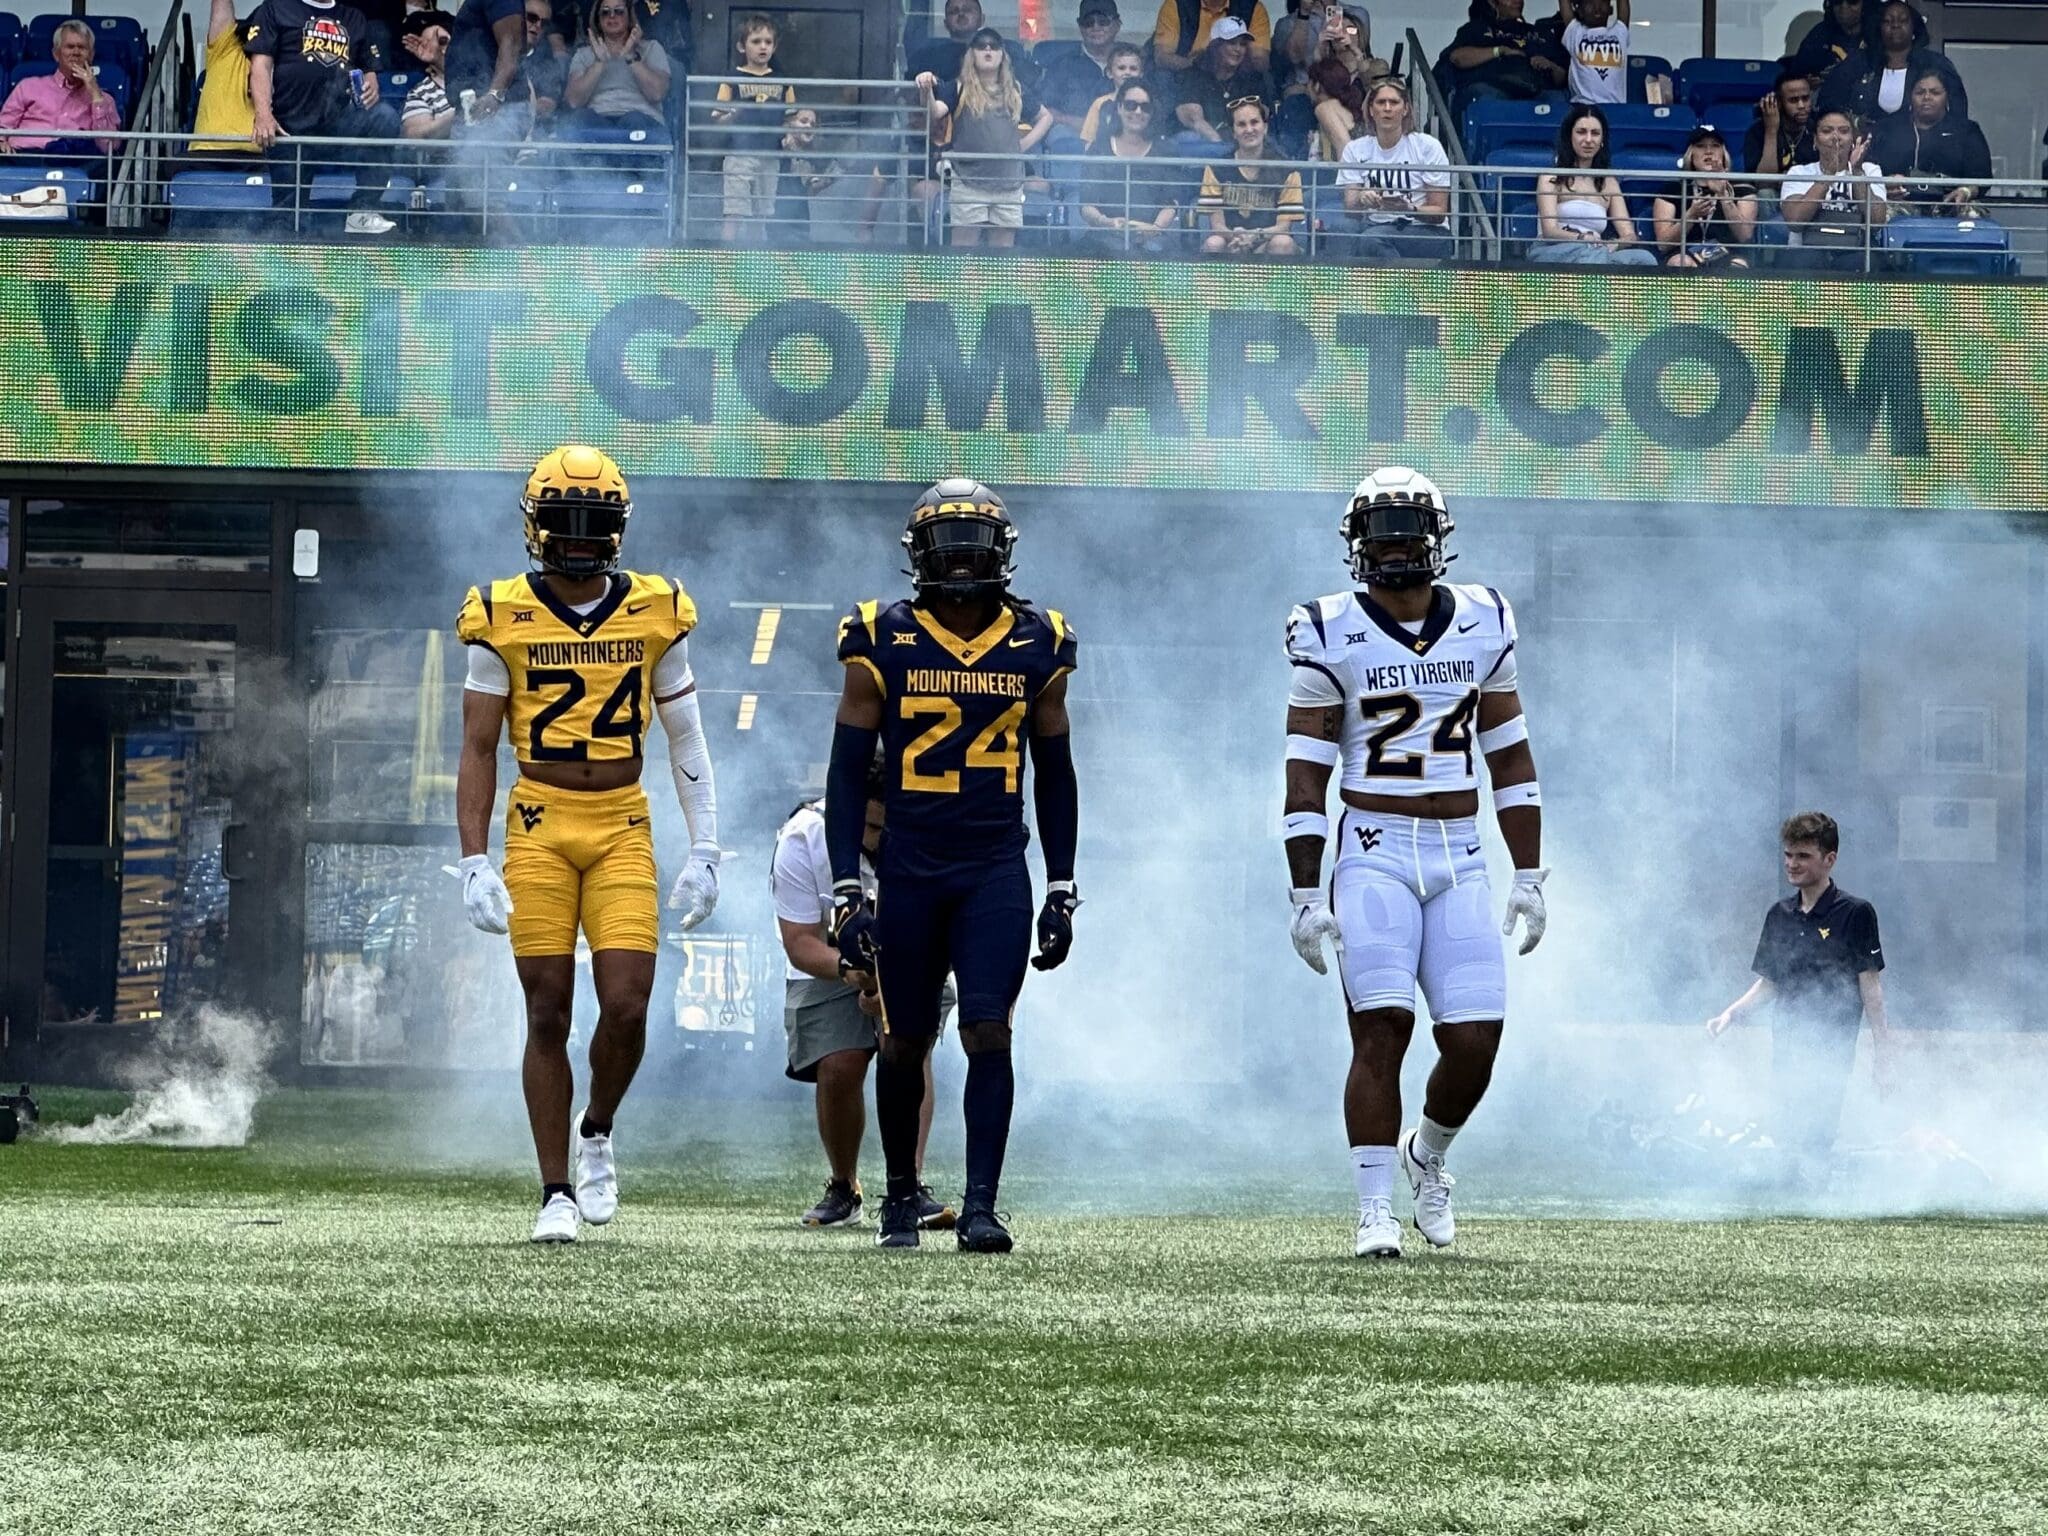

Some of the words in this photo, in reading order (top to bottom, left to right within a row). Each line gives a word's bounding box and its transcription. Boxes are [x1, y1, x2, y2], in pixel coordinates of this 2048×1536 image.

[302, 36, 350, 60] BRAWL
[1581, 42, 1620, 62] WVU
[33, 279, 526, 419] VISIT
[585, 293, 1931, 458] GOMART.COM
[527, 640, 645, 666] MOUNTAINEERS
[906, 669, 1026, 697] MOUNTAINEERS
[1366, 665, 1407, 691] WEST
[1410, 660, 1474, 685] VIRGINIA
[526, 666, 643, 761] 24
[900, 696, 1027, 793] 24
[1359, 686, 1481, 781] 24
